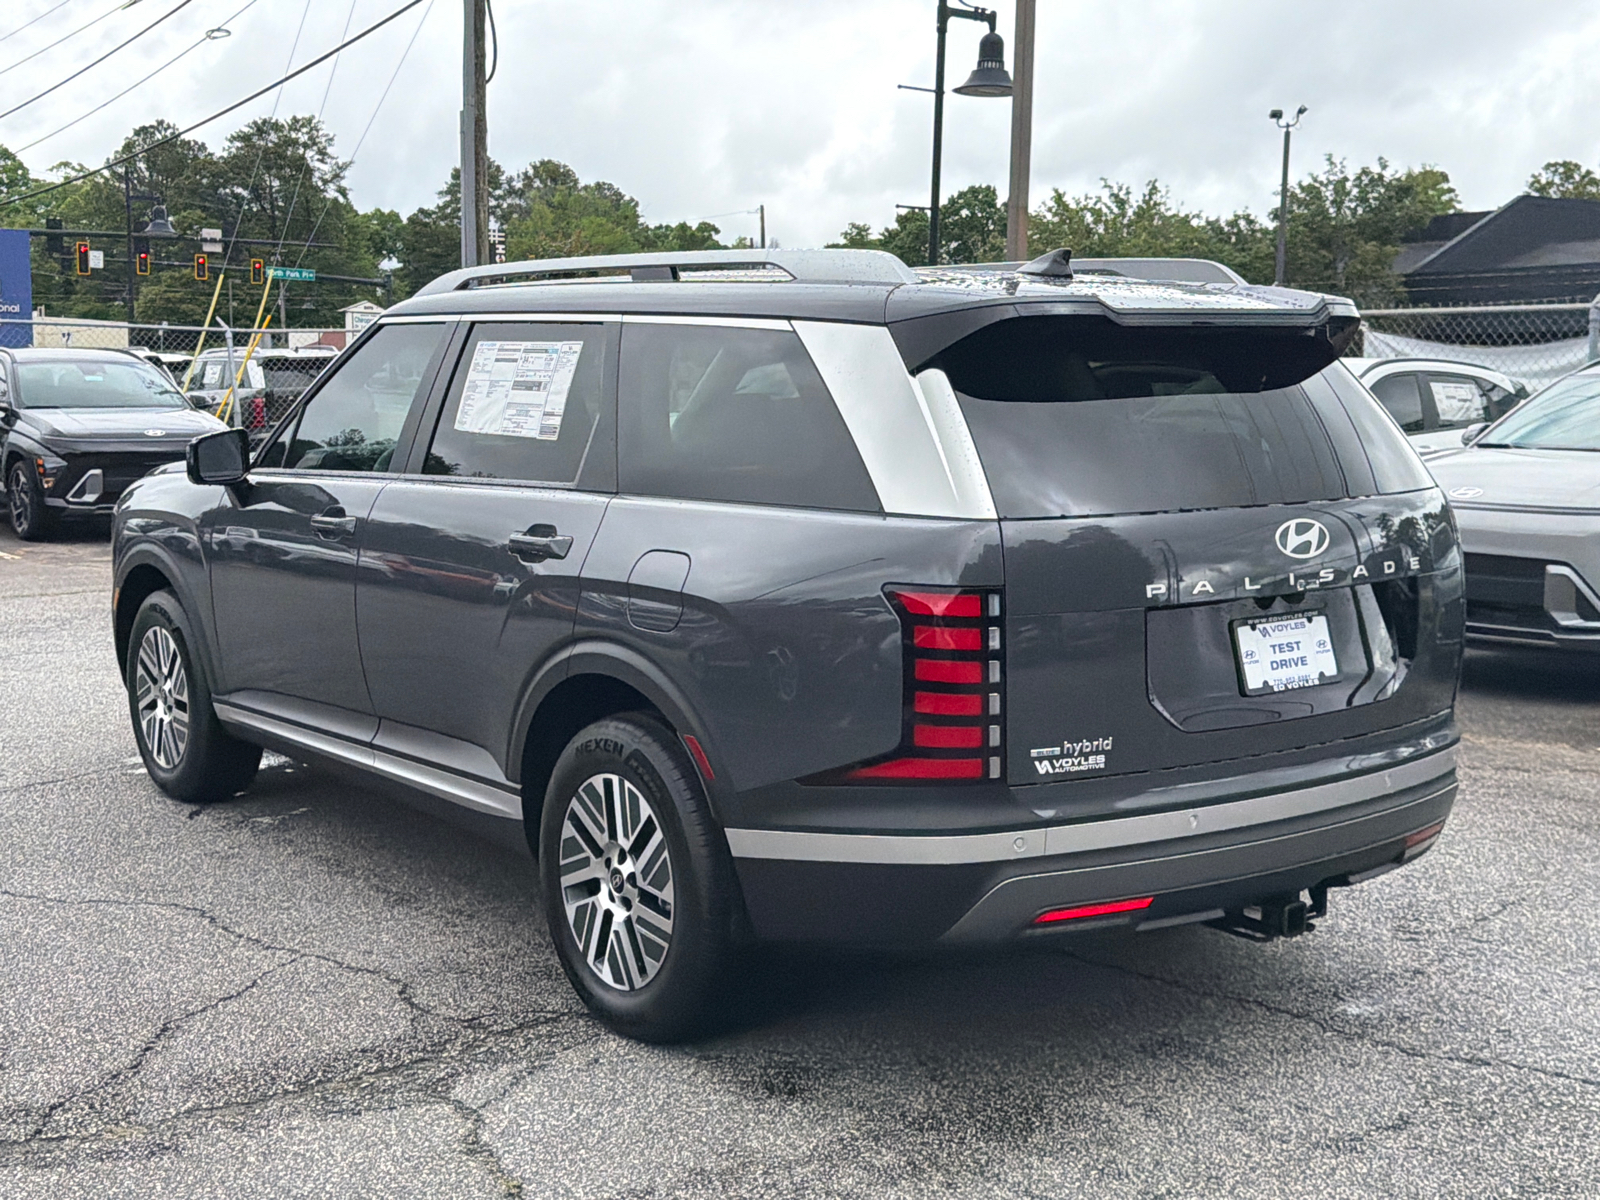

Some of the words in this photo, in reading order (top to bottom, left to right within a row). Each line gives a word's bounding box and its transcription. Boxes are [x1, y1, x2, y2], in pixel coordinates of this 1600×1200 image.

[285, 270, 300, 278] Park
[1146, 556, 1420, 598] PALISADE
[1270, 621, 1306, 633] VOYLES
[1270, 641, 1301, 654] TEST
[1270, 656, 1308, 670] DRIVE
[1286, 678, 1319, 689] VOYLES
[575, 738, 625, 759] NEXEN
[1063, 736, 1113, 757] hybrid
[1053, 754, 1106, 767] VOYLES
[1054, 763, 1105, 773] AUTOMOTIVE
